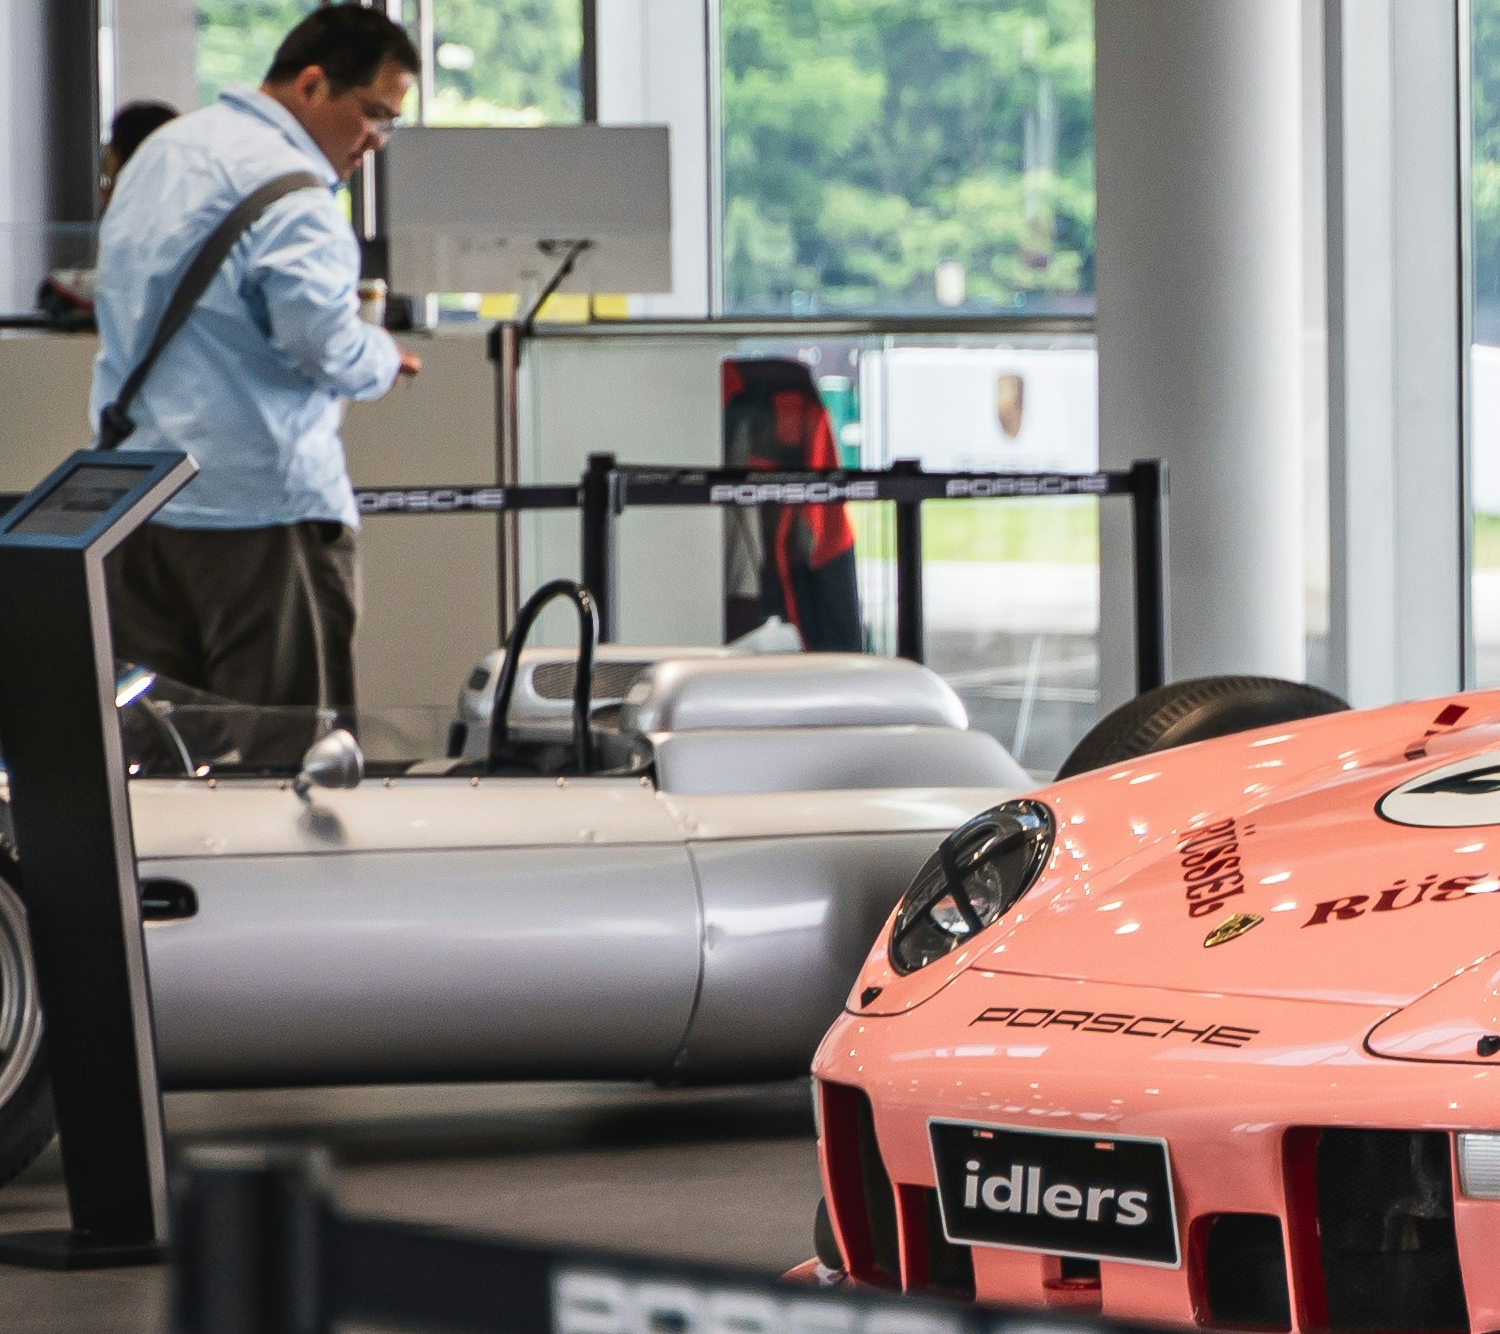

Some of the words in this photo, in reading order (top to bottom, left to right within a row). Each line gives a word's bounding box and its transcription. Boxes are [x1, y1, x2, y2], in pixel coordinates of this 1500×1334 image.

[355, 468, 504, 513] ORSCHE
[968, 1005, 1261, 1049] PORSCHE
[963, 1158, 1150, 1227] idlers
